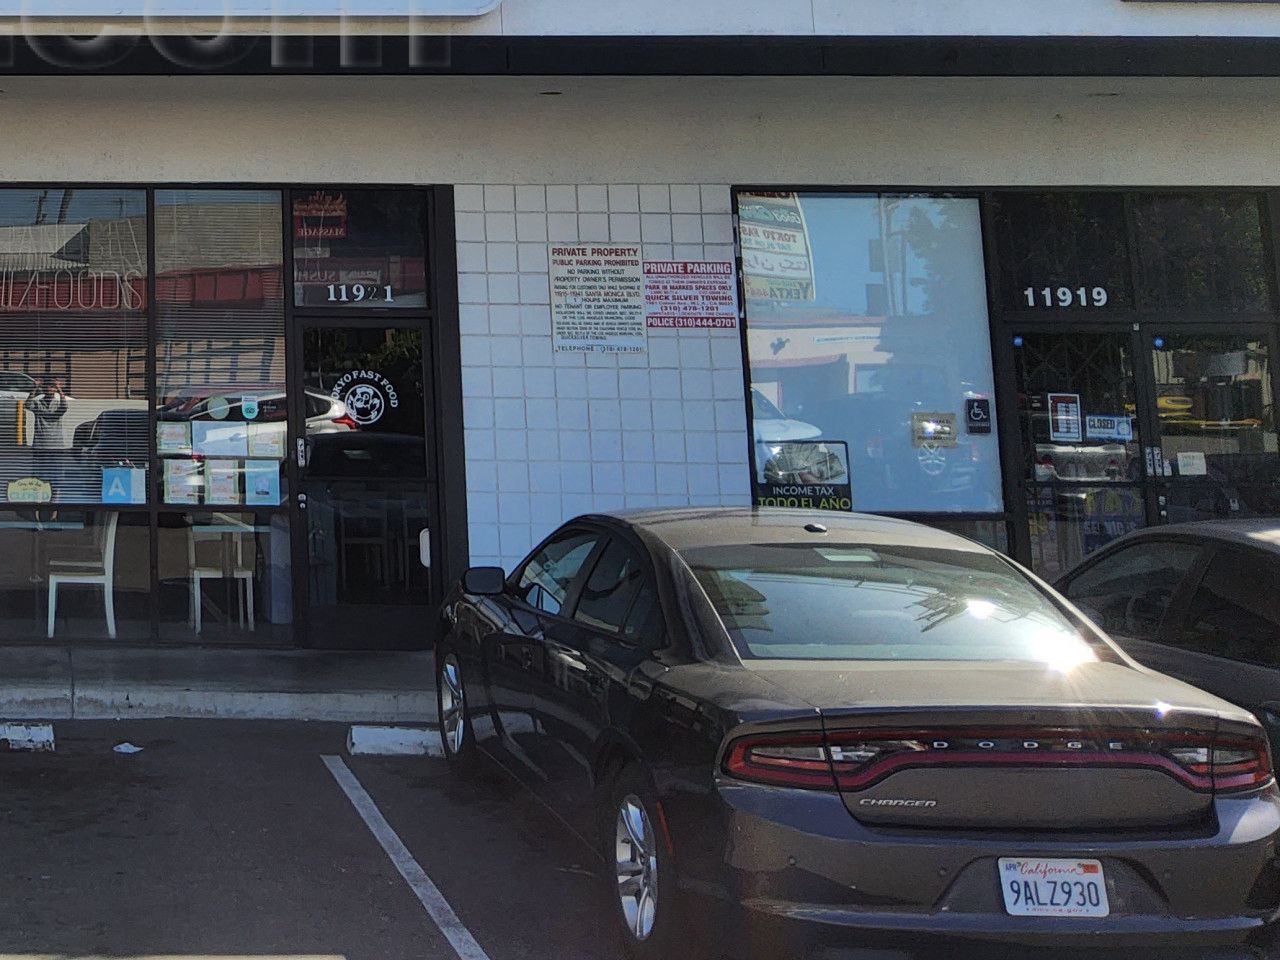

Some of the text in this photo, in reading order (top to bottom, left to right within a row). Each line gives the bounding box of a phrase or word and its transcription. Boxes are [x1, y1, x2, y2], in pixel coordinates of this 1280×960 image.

[552, 248, 638, 256] PRIVATE PROPERTY
[644, 263, 731, 273] PRIVATE PARKING
[1024, 286, 1108, 306] 11919
[647, 318, 674, 326] POLICE
[331, 370, 398, 407] OKYO FAST FOOD
[1088, 420, 1116, 430] CLOSED
[108, 477, 126, 496] A
[773, 486, 834, 495] INCOME TAX
[758, 497, 798, 508] TODO
[820, 495, 851, 509] AÑO
[933, 741, 1122, 749] DODGE
[859, 798, 937, 807] CHARGER
[1020, 861, 1079, 878] California
[1010, 880, 1100, 907] 9ALZ930
